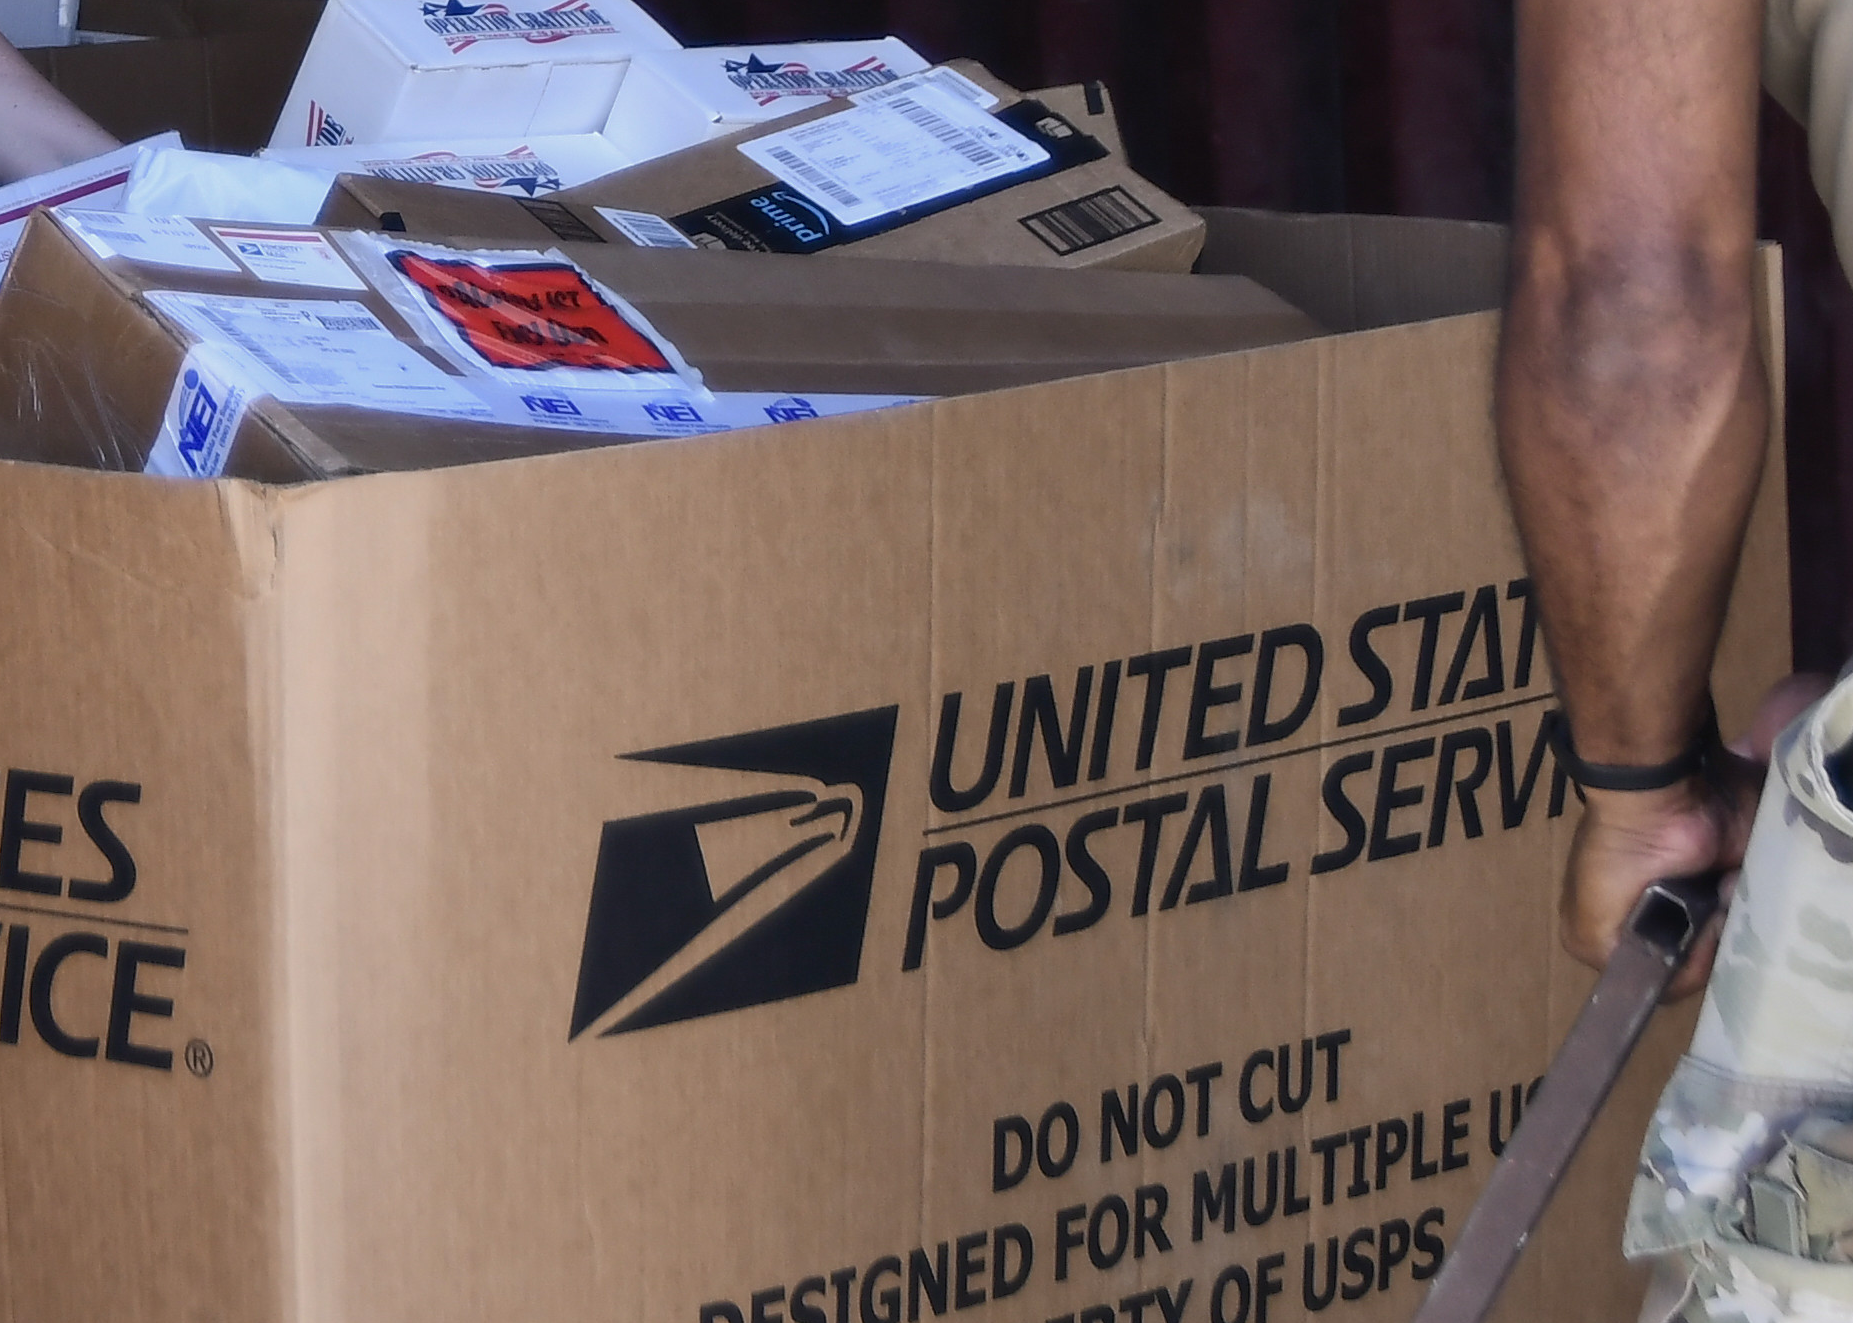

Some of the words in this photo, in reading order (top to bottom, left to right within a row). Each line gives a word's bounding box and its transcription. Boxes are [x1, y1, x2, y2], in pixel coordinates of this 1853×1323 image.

[424, 13, 518, 34] OPERATION
[517, 9, 610, 30] GRATITUDE
[728, 71, 819, 91] OPERATION
[460, 160, 559, 180] OPERATION
[751, 194, 823, 244] prime
[178, 382, 218, 472] NEI
[519, 394, 582, 416] NEI
[641, 403, 704, 422] NEI
[929, 623, 1326, 812] UNITED
[1336, 577, 1542, 727] STAT
[901, 786, 1288, 973] POSTAL
[1309, 710, 1569, 877] SERVI
[991, 1100, 1080, 1193] DO
[1099, 1062, 1224, 1161] NOT
[1238, 1029, 1352, 1127] CUT
[1054, 1182, 1170, 1284] FOR
[1189, 1098, 1471, 1242] MULTIPLE
[1301, 1208, 1448, 1314] USPS
